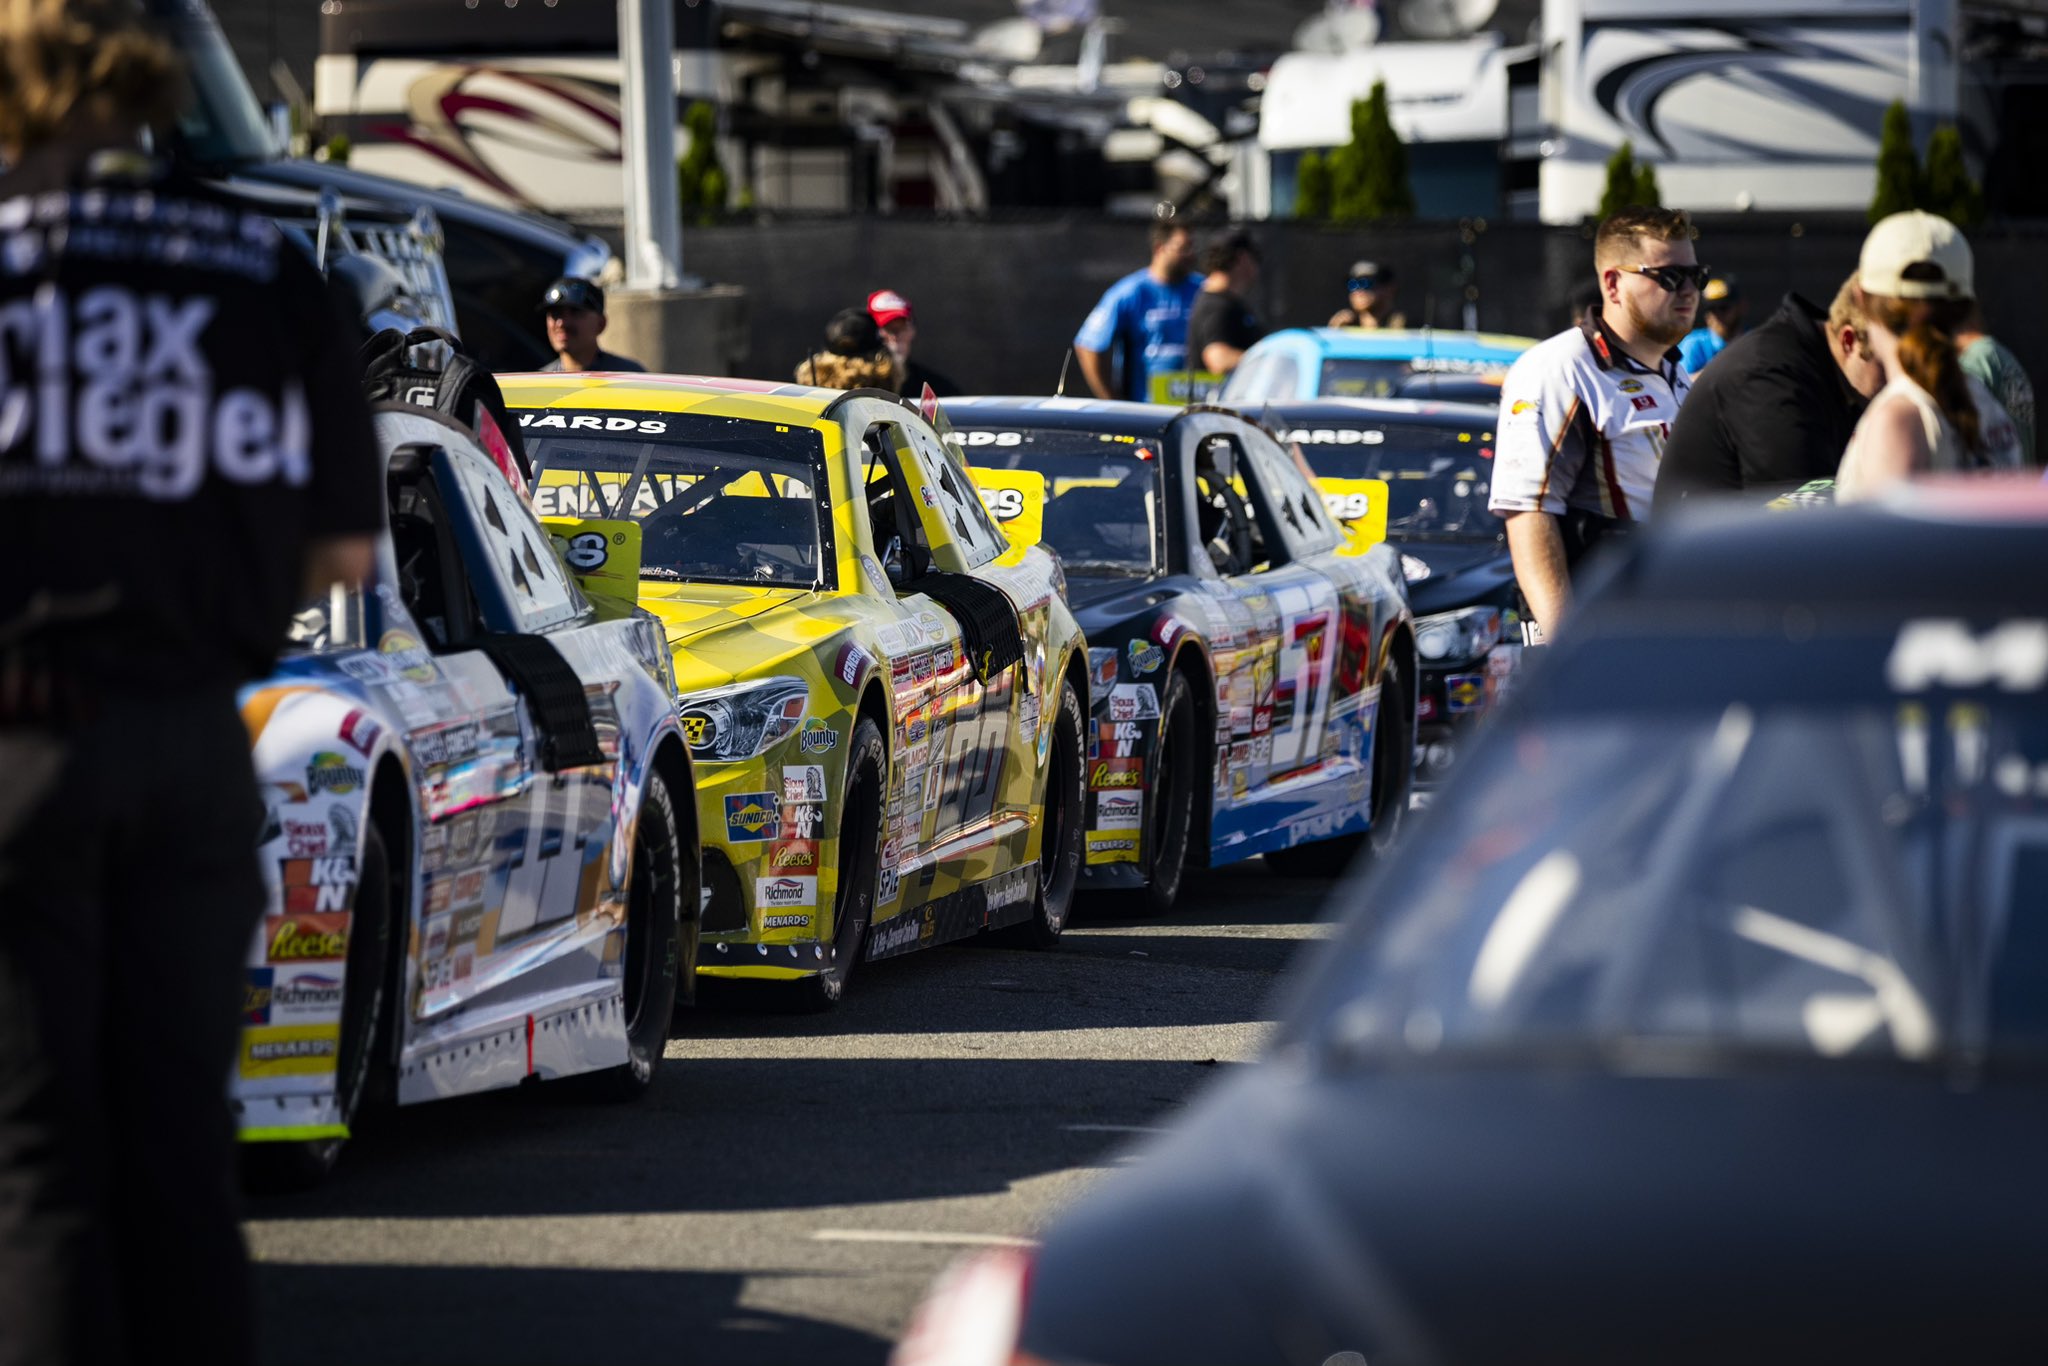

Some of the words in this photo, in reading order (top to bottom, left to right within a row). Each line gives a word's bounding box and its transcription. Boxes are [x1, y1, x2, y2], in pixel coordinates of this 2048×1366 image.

[801, 728, 837, 752] Bounty
[784, 776, 805, 789] Sioux
[1091, 762, 1140, 787] Reese's
[729, 809, 774, 826] SUNOCO
[772, 846, 815, 867] Reese's
[765, 882, 804, 900] Richmond
[764, 915, 809, 928] MENARDS
